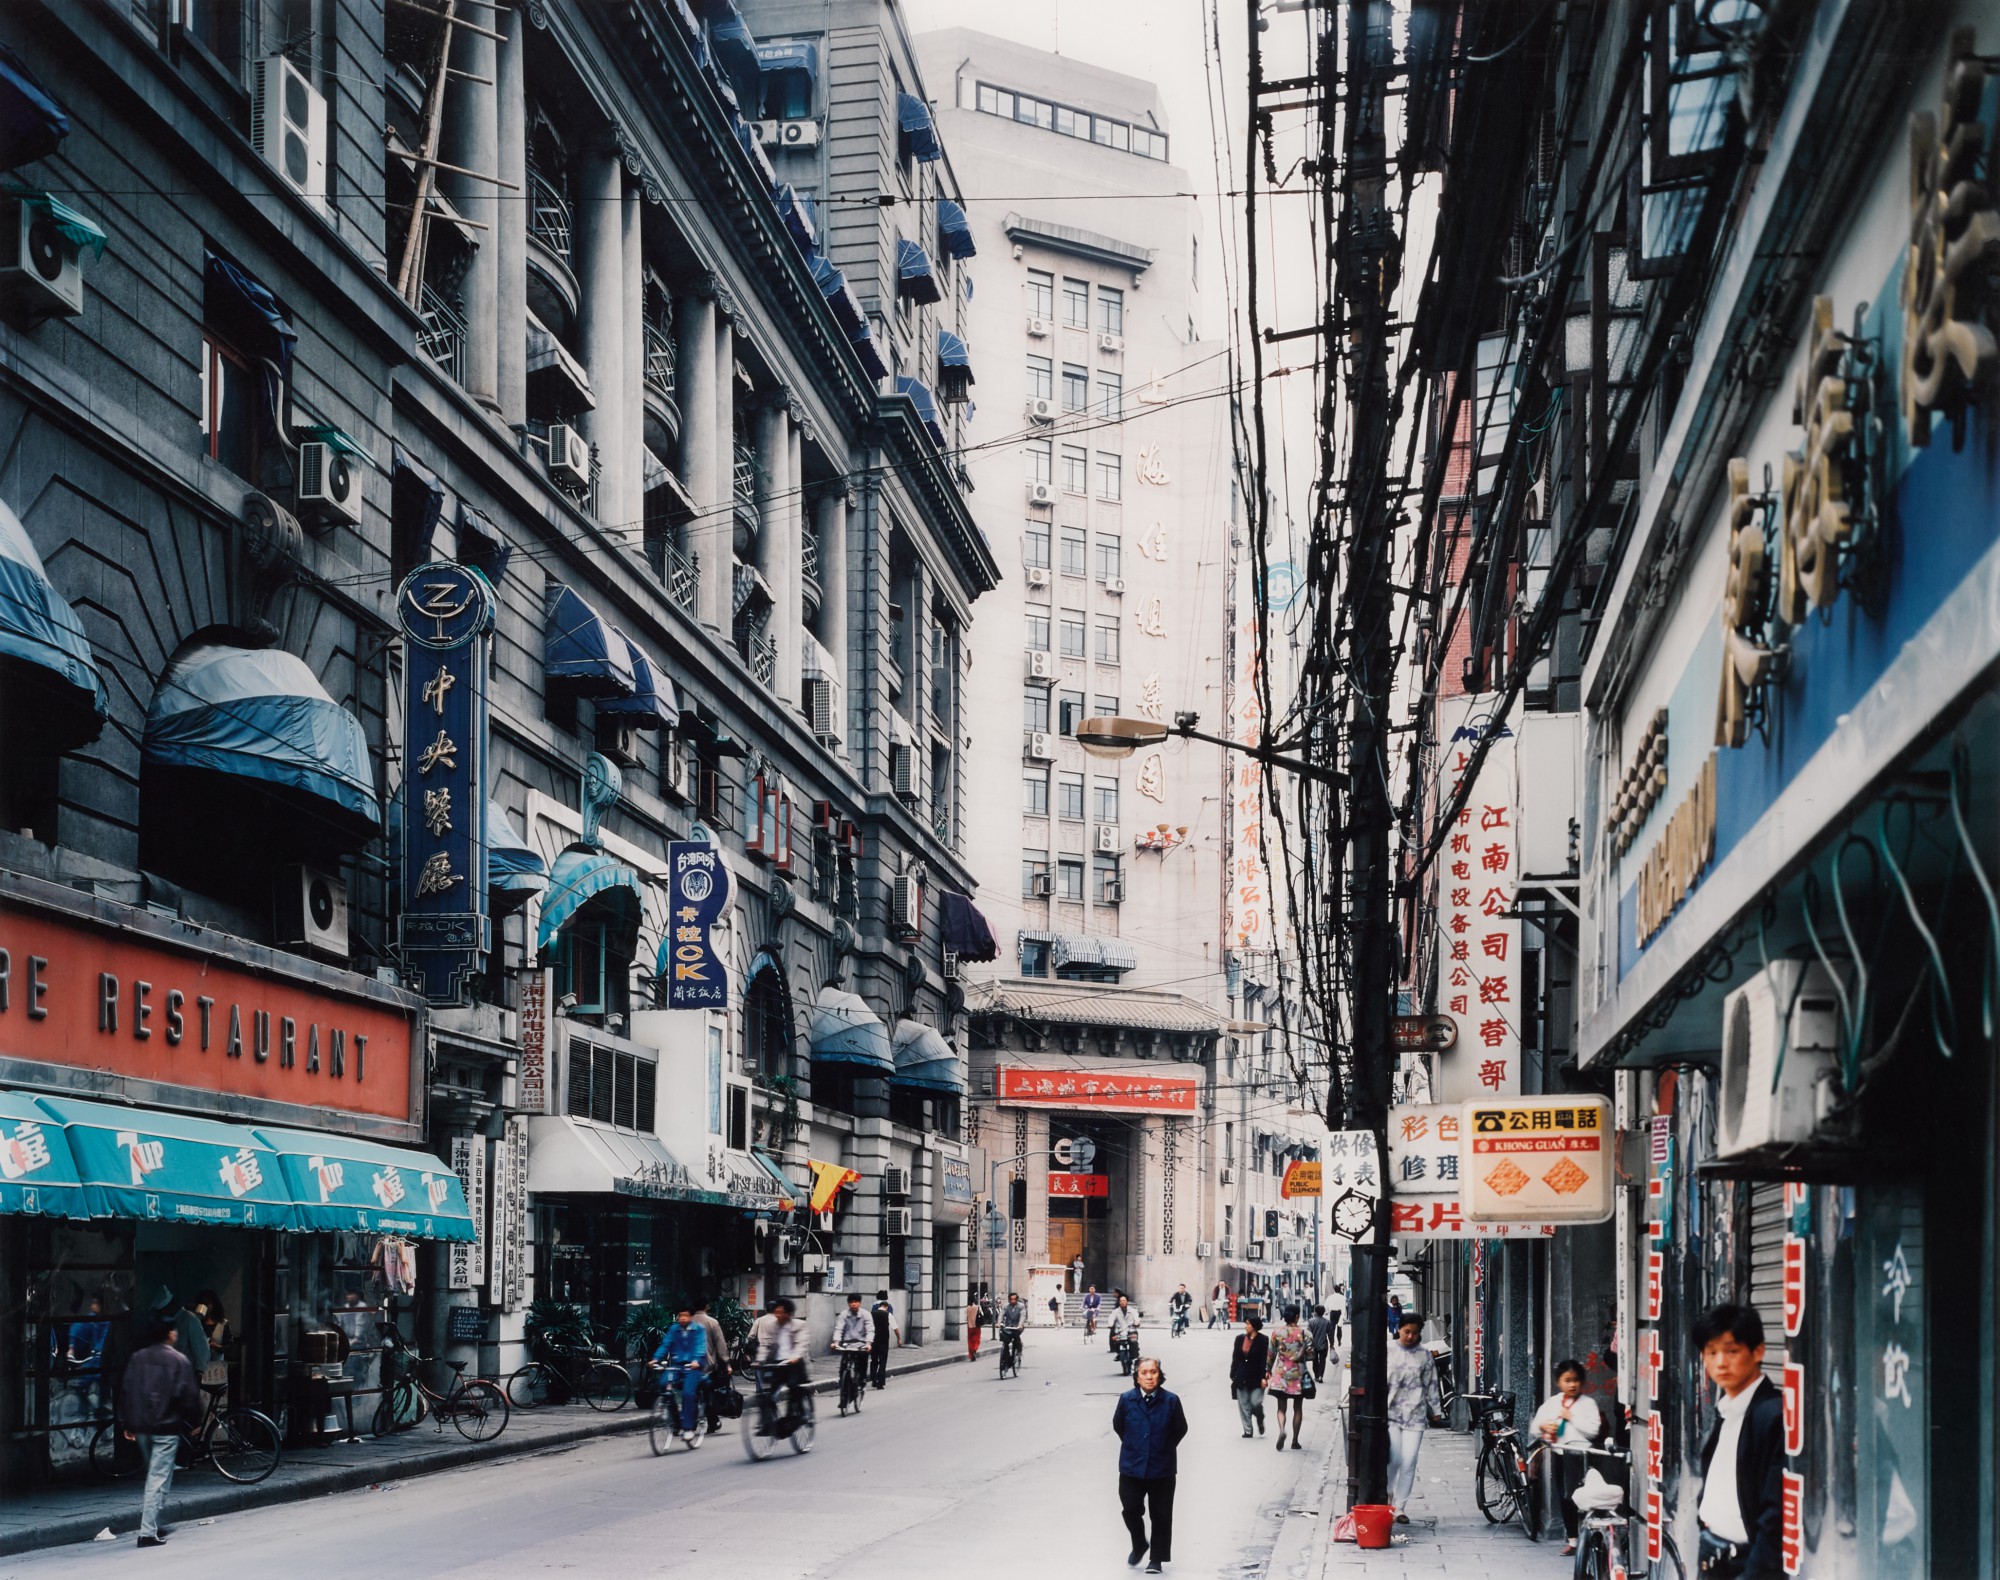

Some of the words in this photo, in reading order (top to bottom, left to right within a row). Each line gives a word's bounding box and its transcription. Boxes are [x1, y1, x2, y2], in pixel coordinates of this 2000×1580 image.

[1449, 752, 1472, 1016] 上市机电设备总公司
[676, 906, 710, 981] 卡拉OK
[1478, 804, 1511, 1092] 江南公司经营部
[98, 972, 368, 1083] RESTAURANT
[1401, 1114, 1458, 1142] 彩色
[1509, 1109, 1597, 1130] 公用電話
[116, 1131, 163, 1186] 7UP
[1330, 1133, 1379, 1159] 快修
[1494, 1141, 1534, 1151] KHONG
[1535, 1139, 1566, 1151] GUAN
[218, 1147, 263, 1198] 七喜
[308, 1156, 345, 1203] 7UP
[371, 1165, 406, 1209] 七喜
[421, 1172, 448, 1214] 7UP
[1332, 1161, 1376, 1187] 手表
[1391, 1202, 1466, 1232] 名片
